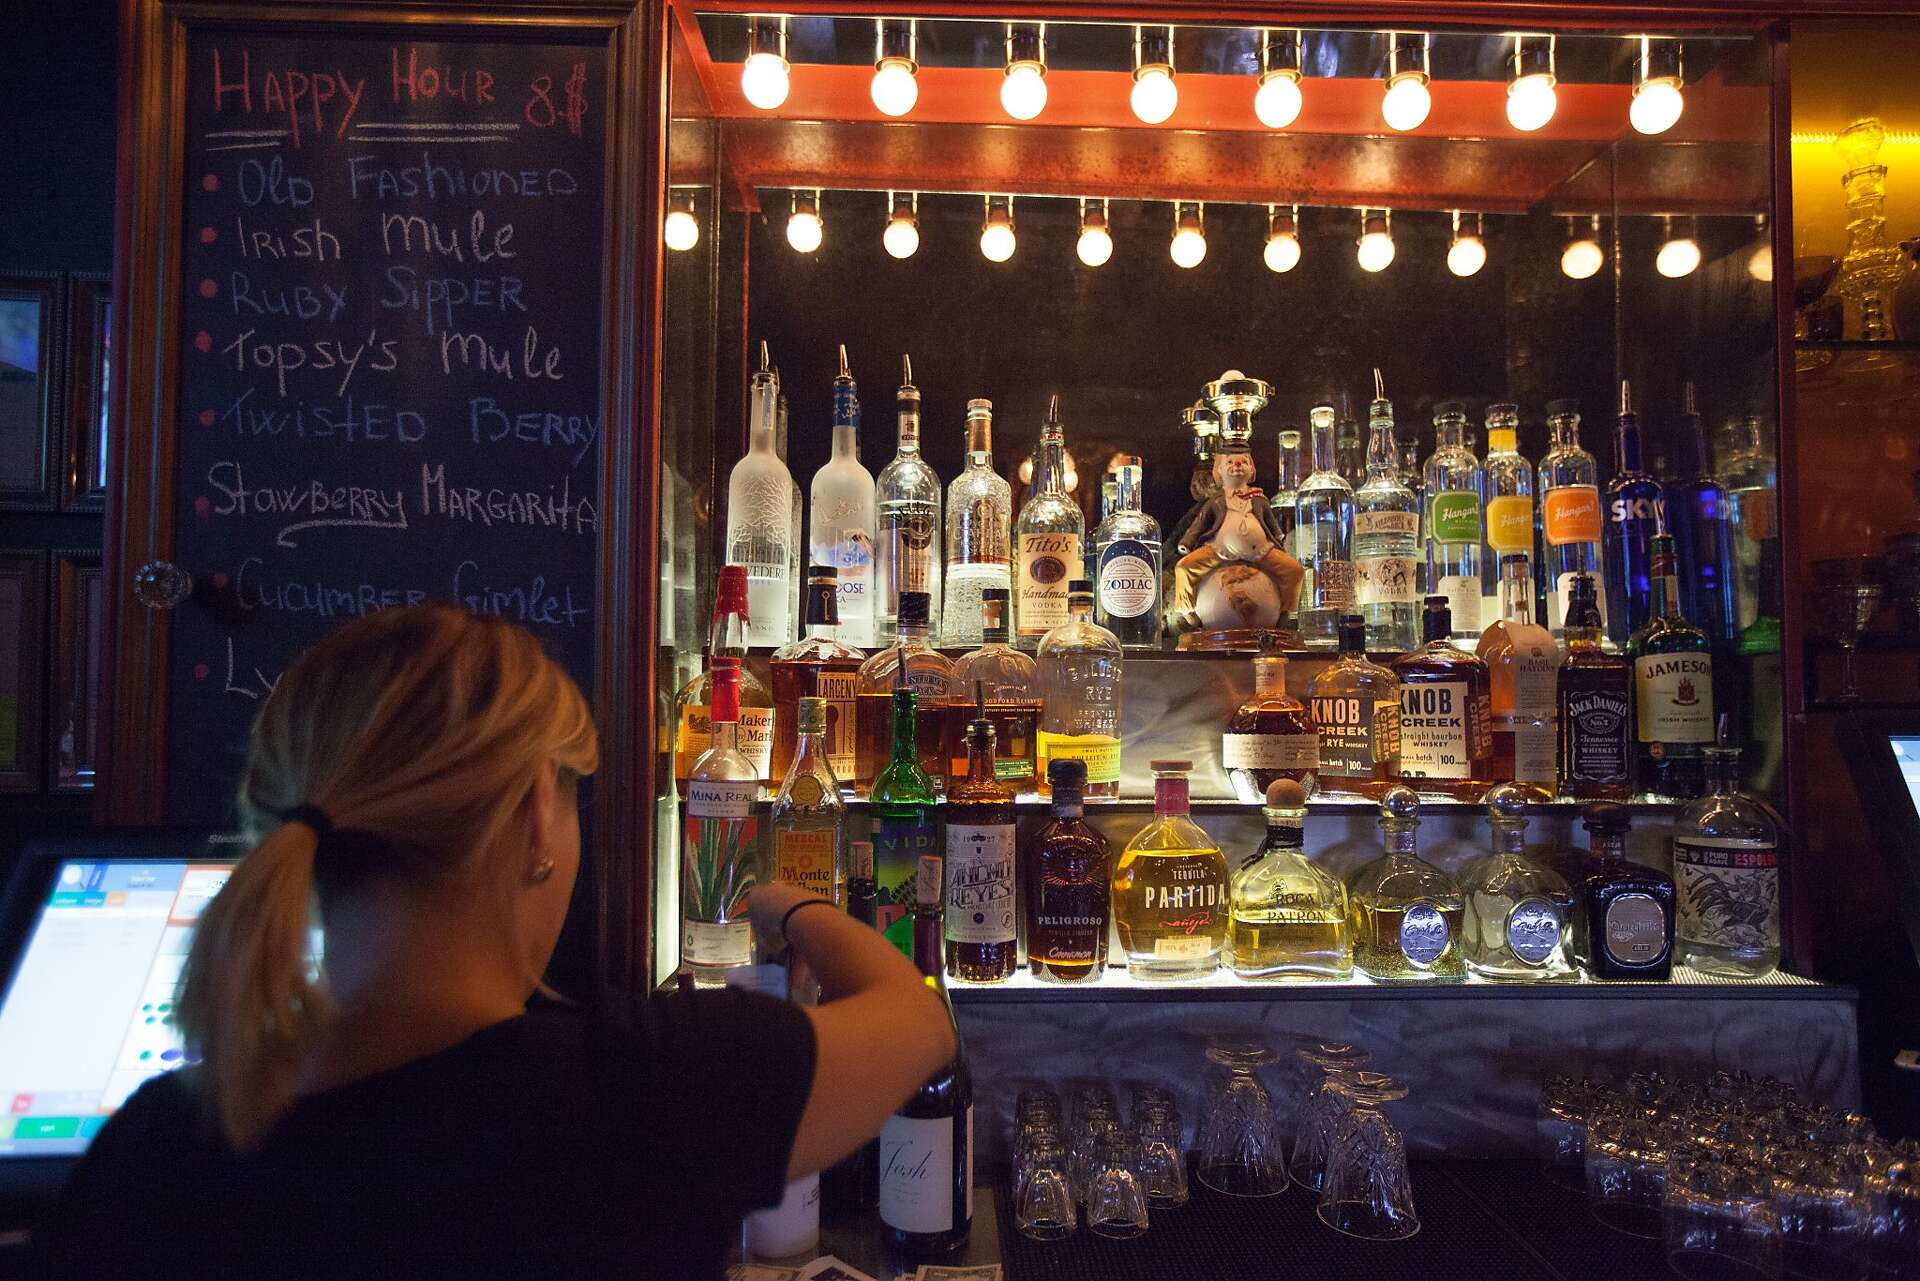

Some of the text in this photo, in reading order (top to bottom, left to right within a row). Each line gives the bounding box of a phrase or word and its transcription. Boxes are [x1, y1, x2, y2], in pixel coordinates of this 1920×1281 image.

[1103, 579, 1152, 590] ZODIAC
[818, 679, 856, 699] LARCENY
[1568, 695, 1628, 717] JACK DANIEL'S
[1312, 699, 1360, 724] KNOB
[1401, 718, 1461, 728] CREEK
[1317, 727, 1368, 736] CREEK
[1431, 732, 1463, 741] bourbon
[1326, 739, 1344, 749] RYE
[1581, 746, 1620, 754] WHISKEY
[1440, 755, 1455, 765] 100
[691, 790, 753, 802] MINA REAL
[782, 865, 830, 881] Monte
[1172, 870, 1206, 880] TEQUILA
[950, 880, 1011, 910] REYES
[1145, 883, 1226, 909] PARTIDA
[1038, 916, 1103, 926] PELIGROSO
